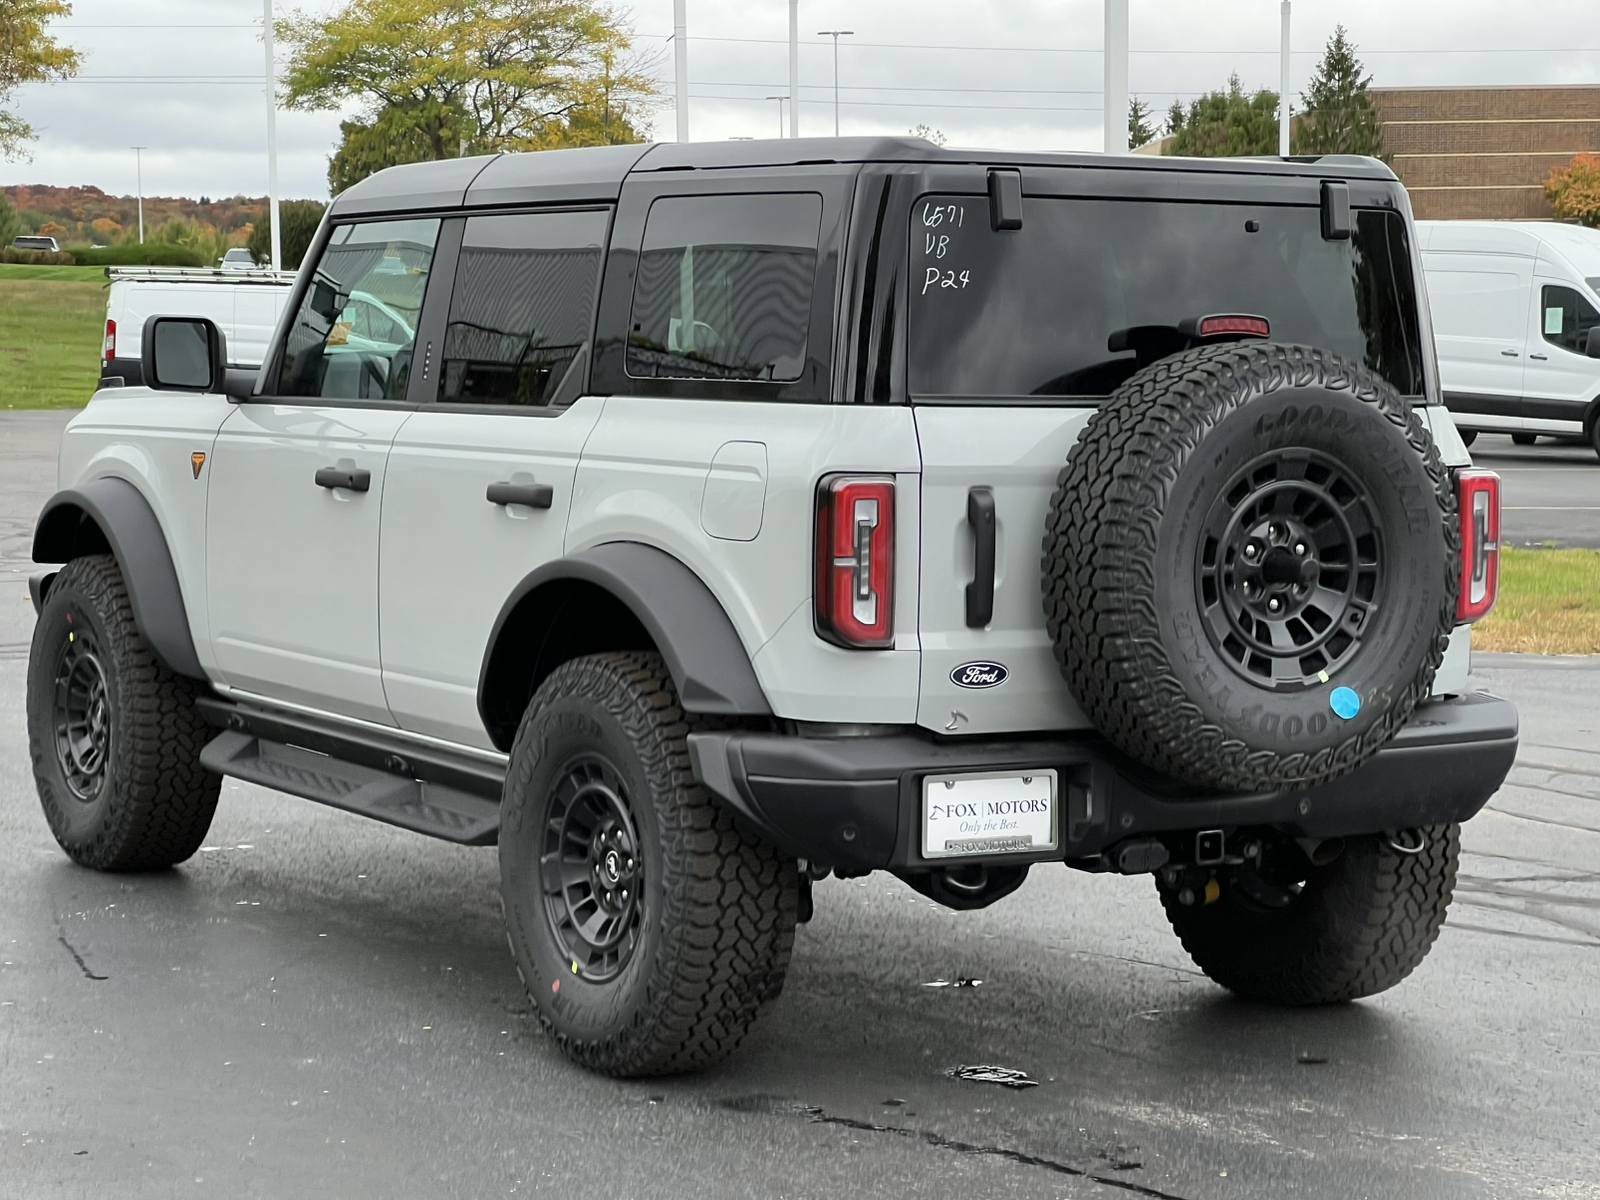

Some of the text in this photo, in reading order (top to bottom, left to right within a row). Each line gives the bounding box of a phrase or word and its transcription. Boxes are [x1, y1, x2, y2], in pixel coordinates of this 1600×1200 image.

[922, 202, 964, 228] 6571
[961, 665, 999, 684] Ford
[946, 798, 1048, 818] FOX MOTORS
[959, 818, 1019, 835] Only the Best.
